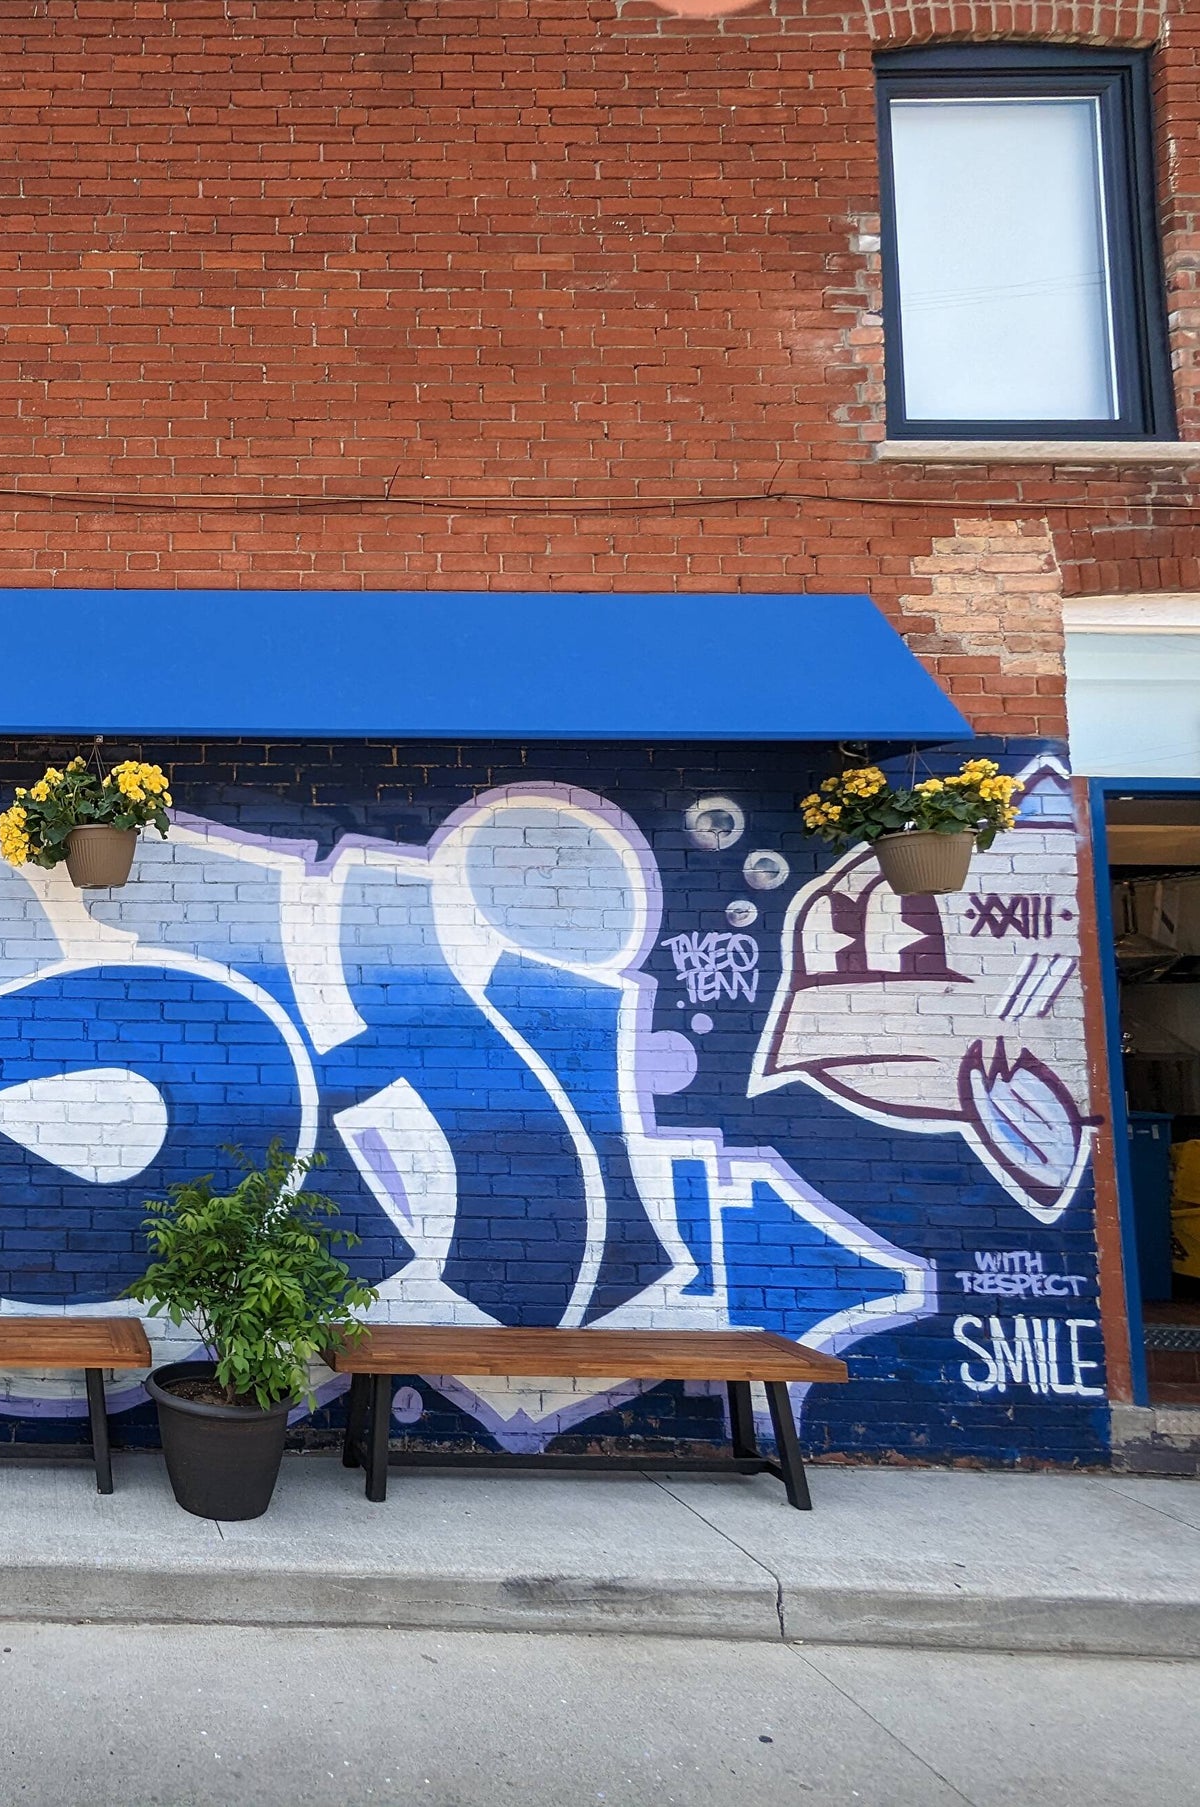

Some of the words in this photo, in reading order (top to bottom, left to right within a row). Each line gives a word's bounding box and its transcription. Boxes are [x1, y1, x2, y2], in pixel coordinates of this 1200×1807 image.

[974, 1251, 1043, 1273] WITH
[955, 1271, 1088, 1299] RESPECT
[953, 1314, 1104, 1395] SMILE
